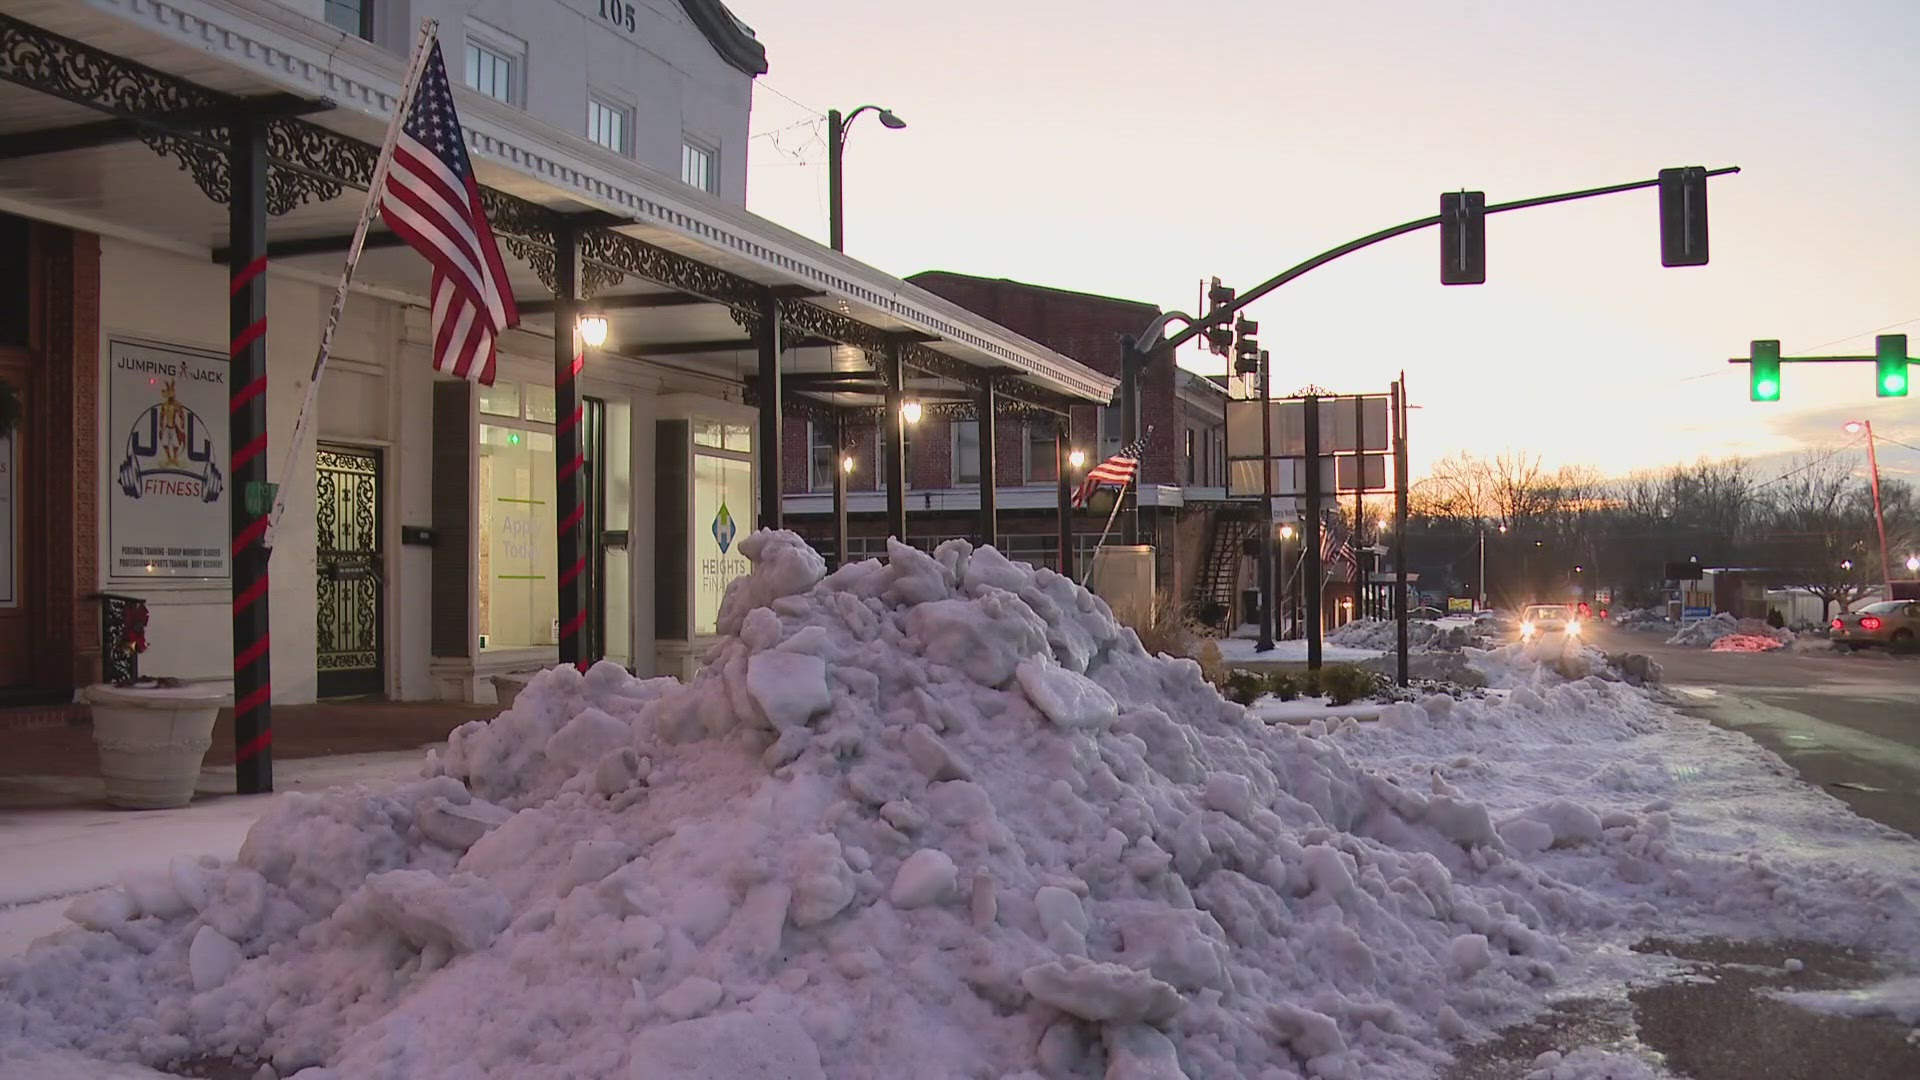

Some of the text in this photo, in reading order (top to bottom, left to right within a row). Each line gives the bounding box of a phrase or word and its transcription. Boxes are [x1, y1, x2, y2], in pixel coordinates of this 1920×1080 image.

[598, 0, 636, 33] 105
[118, 357, 224, 384] JUMPING JACK
[702, 559, 746, 575] HEIGHTS
